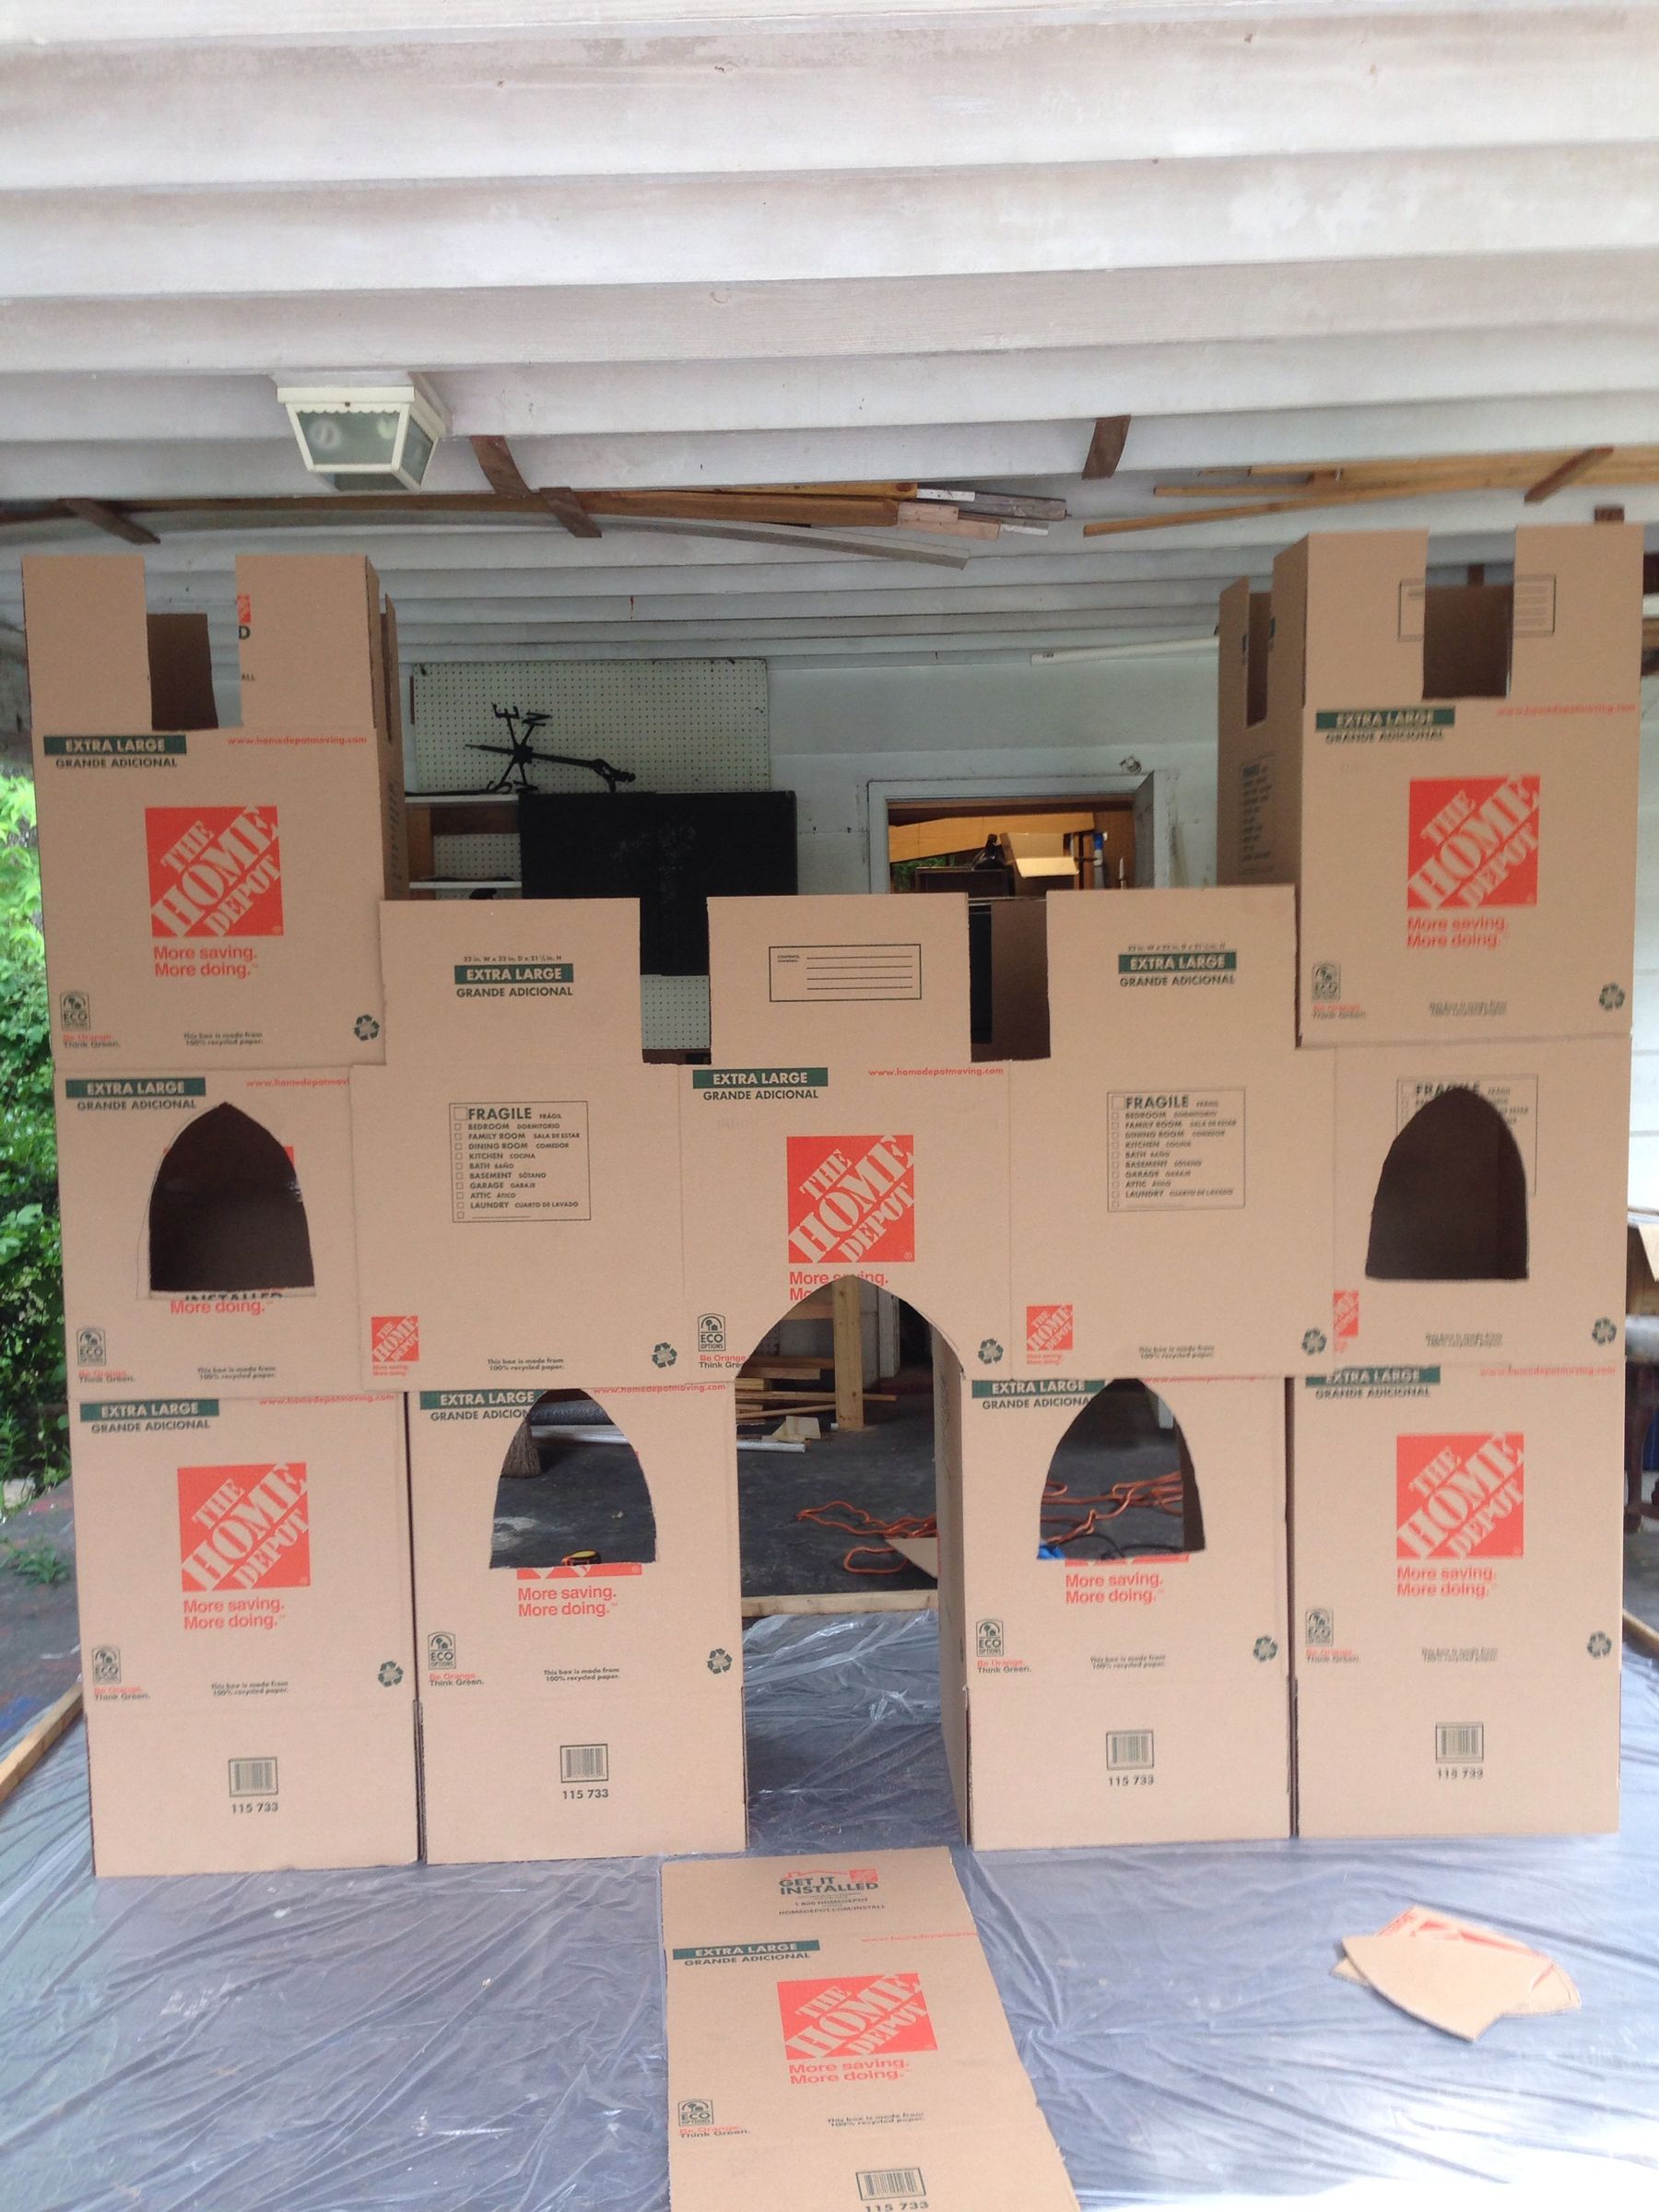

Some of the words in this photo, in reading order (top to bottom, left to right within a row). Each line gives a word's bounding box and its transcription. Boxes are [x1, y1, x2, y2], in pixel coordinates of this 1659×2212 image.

[65, 739, 111, 752] EXTRA
[117, 739, 164, 751] LARGE
[56, 759, 105, 768] GRANDE
[111, 758, 177, 767] ADICIONAL
[160, 820, 215, 874] THE
[152, 805, 278, 936] HOME
[204, 854, 280, 936] DEPOT
[154, 947, 194, 959] More
[200, 947, 257, 961] saving.
[155, 963, 195, 977] More
[200, 963, 250, 979] doing.
[1131, 957, 1174, 971] EXTRA
[1179, 956, 1225, 970] LARGE
[467, 968, 511, 981] EXTRA
[515, 968, 561, 981] LARGE
[1120, 977, 1169, 987] GRANDE
[1171, 975, 1234, 986] ADICIONAL
[457, 987, 506, 997] GRANDE
[509, 986, 572, 996] ADICIONAL
[712, 1073, 758, 1086] EXTRA
[761, 1072, 806, 1085] LARGE
[87, 1083, 133, 1096] EXTRA
[137, 1082, 184, 1094] LARGE
[703, 1090, 752, 1100] GRANDE
[755, 1089, 818, 1099] ADICIONAL
[78, 1100, 126, 1111] GRANDE
[131, 1100, 196, 1109] ADICIONAL
[1126, 1096, 1189, 1109] FRAGILE
[469, 1108, 531, 1120] FRAGILE
[800, 1148, 853, 1201] THE
[790, 1135, 913, 1264] HOME
[839, 1182, 914, 1263] DEPOT
[790, 1271, 829, 1285] More
[171, 1301, 210, 1313] More
[216, 1300, 265, 1315] doing.
[1028, 1305, 1073, 1350] HOME
[371, 1316, 419, 1361] HOME
[700, 1334, 723, 1342] ECO
[1327, 1370, 1371, 1382] EXTRA
[1374, 1369, 1419, 1381] LARGE
[992, 1382, 1036, 1394] EXTRA
[1040, 1381, 1085, 1392] LARGE
[1316, 1388, 1363, 1399] GRANDE
[1367, 1387, 1430, 1398] ADICIONAL
[441, 1393, 485, 1406] EXTRA
[488, 1392, 534, 1404] LARGE
[982, 1399, 1030, 1409] GRANDE
[101, 1404, 146, 1418] EXTRA
[152, 1403, 198, 1416] LARGE
[430, 1411, 479, 1422] GRANDE
[91, 1423, 141, 1433] GRANDE
[146, 1421, 209, 1431] ADICIONAL
[1409, 1446, 1461, 1498] THE
[192, 1479, 244, 1529] THE
[1398, 1434, 1523, 1560] HOME
[1447, 1481, 1523, 1559] DEPOT
[182, 1464, 307, 1592] HOME
[232, 1508, 309, 1590] DEPOT
[1065, 1573, 1104, 1587] More
[1109, 1572, 1163, 1587] saving.
[1397, 1567, 1436, 1581] More
[1441, 1567, 1497, 1583] saving.
[518, 1587, 557, 1601] More
[561, 1586, 617, 1603] saving.
[1065, 1590, 1105, 1604] More
[1109, 1588, 1156, 1604] doing.
[1397, 1583, 1436, 1595] More
[1441, 1583, 1488, 1598] doing.
[185, 1598, 223, 1614] More
[229, 1598, 285, 1615] saving.
[518, 1604, 558, 1617] More
[561, 1603, 609, 1617] doing.
[185, 1616, 225, 1630] More
[229, 1614, 276, 1631] doing.
[979, 1640, 1001, 1648] ECO
[430, 1652, 453, 1661] ECO
[779, 1877, 817, 1887] GET
[820, 1877, 834, 1886] IT
[781, 1882, 878, 1894] INSTALLED
[695, 1947, 743, 1957] EXTRA
[747, 1944, 796, 1953] LARGE
[741, 1953, 810, 1962] ADICIONAL
[795, 1985, 853, 2018] THE
[786, 1974, 921, 2057] HOME
[845, 2001, 928, 2055] DEPOT
[789, 2064, 836, 2074] More
[842, 2058, 910, 2070] saving.
[790, 2074, 838, 2084] More
[844, 2069, 903, 2081] doing.
